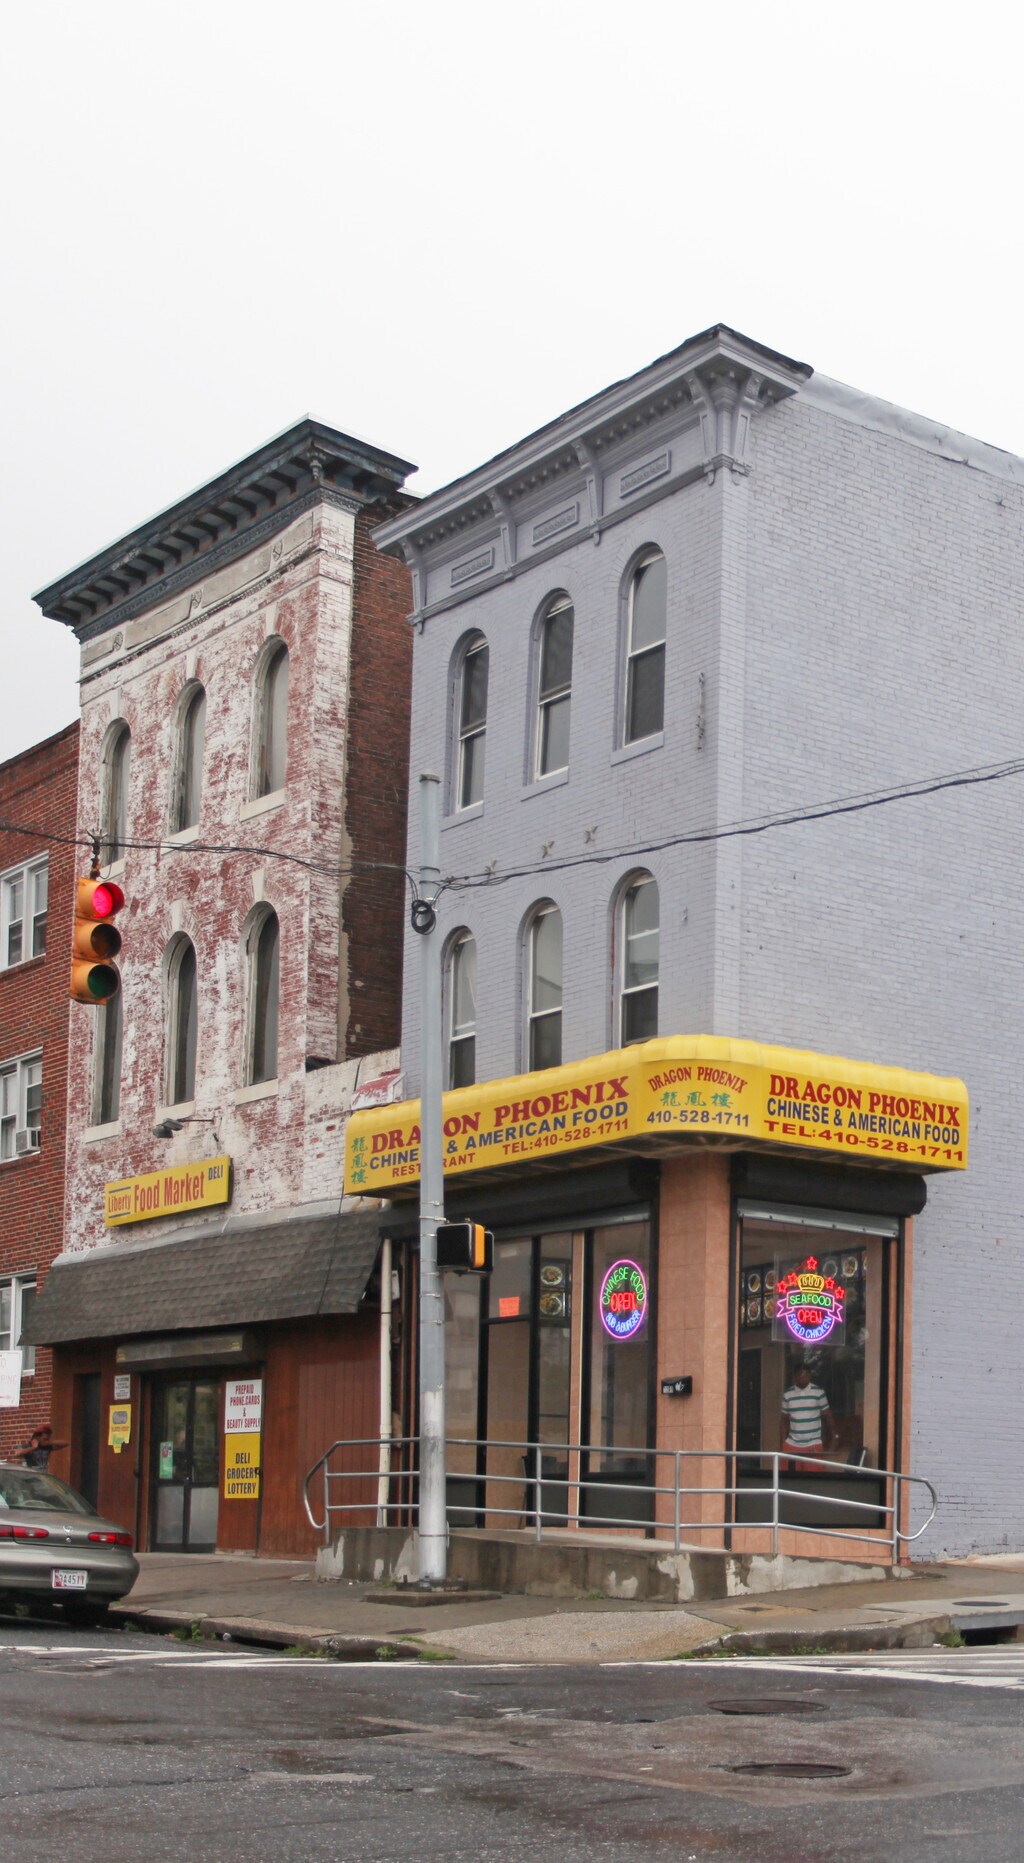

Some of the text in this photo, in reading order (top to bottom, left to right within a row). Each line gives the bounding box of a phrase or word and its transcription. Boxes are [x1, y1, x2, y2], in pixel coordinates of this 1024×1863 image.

[648, 1066, 748, 1094] DRAGON PHOENIX
[770, 1074, 961, 1127] DRAGON PHOENIX
[371, 1076, 629, 1154] DRAON PHOENIX
[647, 1110, 749, 1127] 410-528-1711
[767, 1098, 960, 1145] CHINESE & AMERICAN FOOD
[370, 1100, 628, 1170] CHINE & AMERICAN FOOD
[764, 1120, 963, 1161] TEL:410-528-1711
[208, 1165, 224, 1181] DELI
[108, 1171, 205, 1213] Liberty Food Market
[602, 1266, 645, 1305] CHINESE FOOD
[611, 1292, 636, 1312] OPEN
[790, 1294, 831, 1306] SEAFOOD
[619, 1309, 641, 1333] BURGER
[788, 1313, 832, 1338] FRIED CHICKEN
[797, 1309, 822, 1323] OPEN
[235, 1383, 254, 1395] PREPAID
[227, 1419, 243, 1429] BEAUTY
[235, 1453, 250, 1465] DELI
[228, 1482, 256, 1494] LOTTERY
